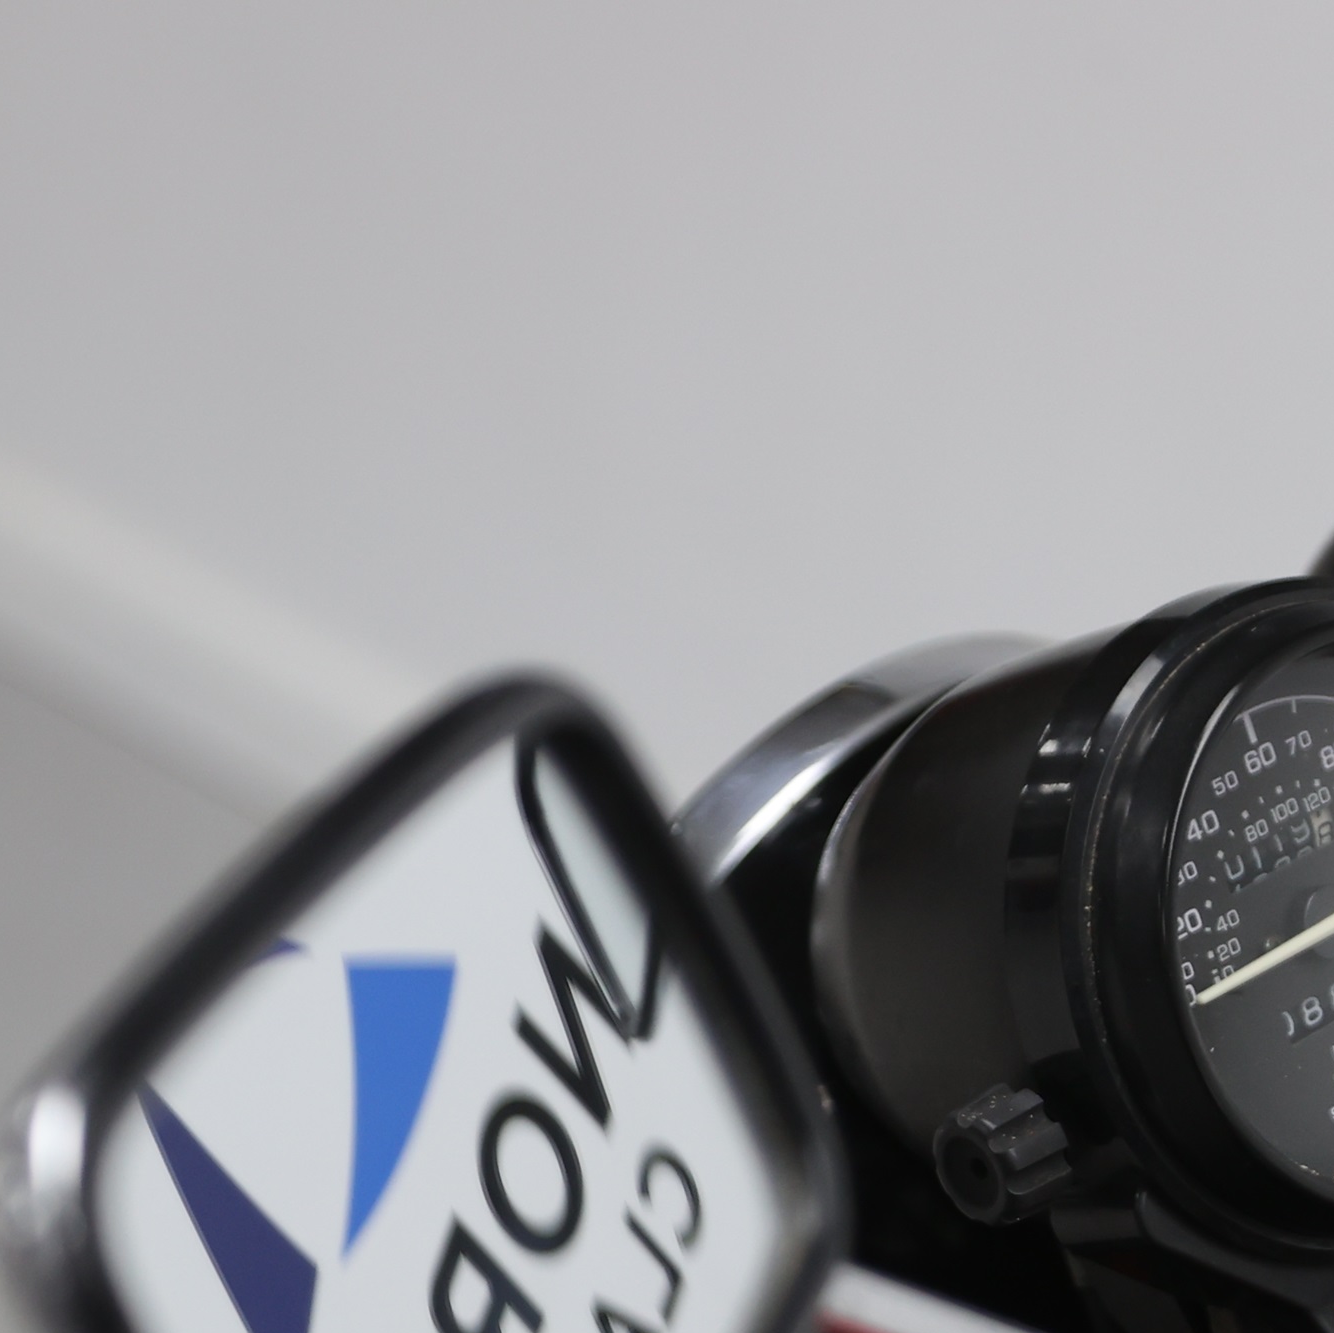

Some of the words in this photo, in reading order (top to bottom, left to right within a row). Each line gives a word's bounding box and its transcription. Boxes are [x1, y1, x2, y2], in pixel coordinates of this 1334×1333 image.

[1285, 730, 1312, 755] 70
[1244, 742, 1276, 774] 60
[1212, 770, 1239, 796] 50
[1270, 797, 1299, 823] 100
[1302, 786, 1331, 812] 120
[1187, 810, 1219, 840] 40
[1244, 818, 1269, 842] 80
[1216, 909, 1240, 931] 40
[1216, 937, 1241, 962] 20
[1181, 961, 1195, 980] 0
